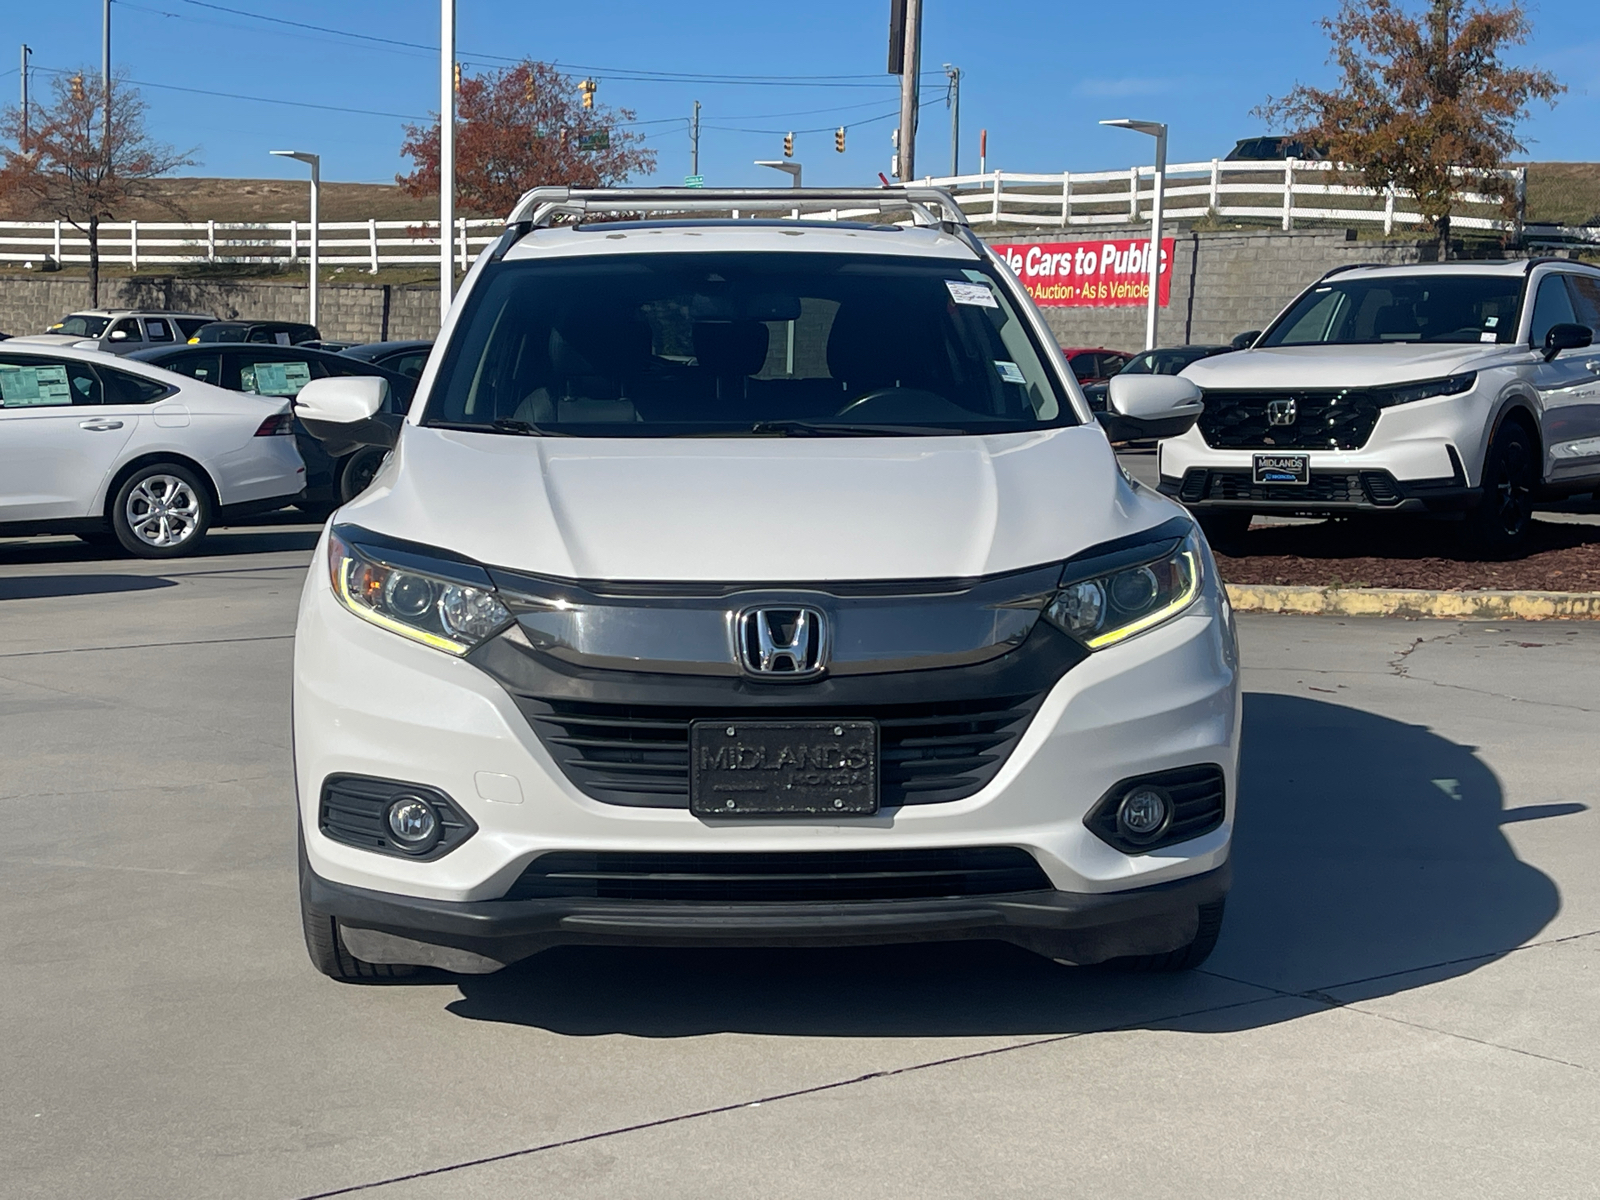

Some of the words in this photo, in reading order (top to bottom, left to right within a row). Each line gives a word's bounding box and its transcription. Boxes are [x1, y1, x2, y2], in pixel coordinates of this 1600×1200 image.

[1025, 246, 1071, 276] Cars
[1075, 247, 1097, 275] to
[1034, 282, 1074, 299] Auction
[1081, 282, 1096, 298] As
[1098, 281, 1107, 298] Is
[1258, 459, 1303, 467] MIDLANDS
[699, 744, 868, 770] MIDLANDS
